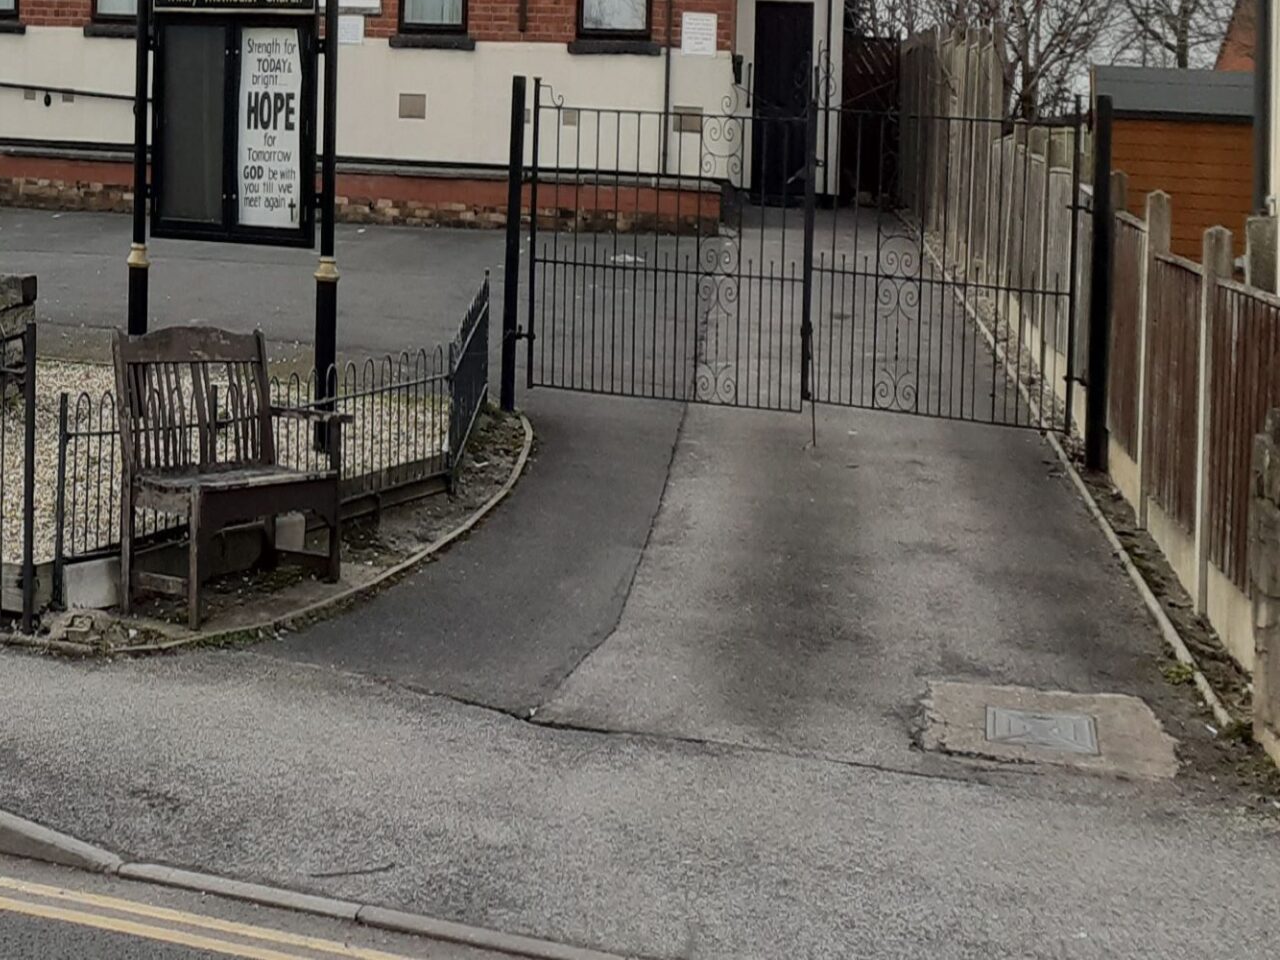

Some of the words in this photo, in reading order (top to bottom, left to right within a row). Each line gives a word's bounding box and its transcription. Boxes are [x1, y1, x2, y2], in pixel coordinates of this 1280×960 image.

[247, 37, 280, 57] Strength
[284, 38, 296, 55] for
[257, 58, 288, 73] TODAY
[247, 91, 295, 131] HOPE
[263, 132, 276, 147] for
[247, 148, 292, 162] Tomorrow
[243, 165, 264, 179] GOD
[268, 167, 278, 180] be
[280, 168, 296, 181] with
[244, 183, 259, 195] you
[263, 182, 274, 193] till
[278, 182, 293, 194] we
[243, 195, 262, 207] meet
[264, 195, 286, 211] again
